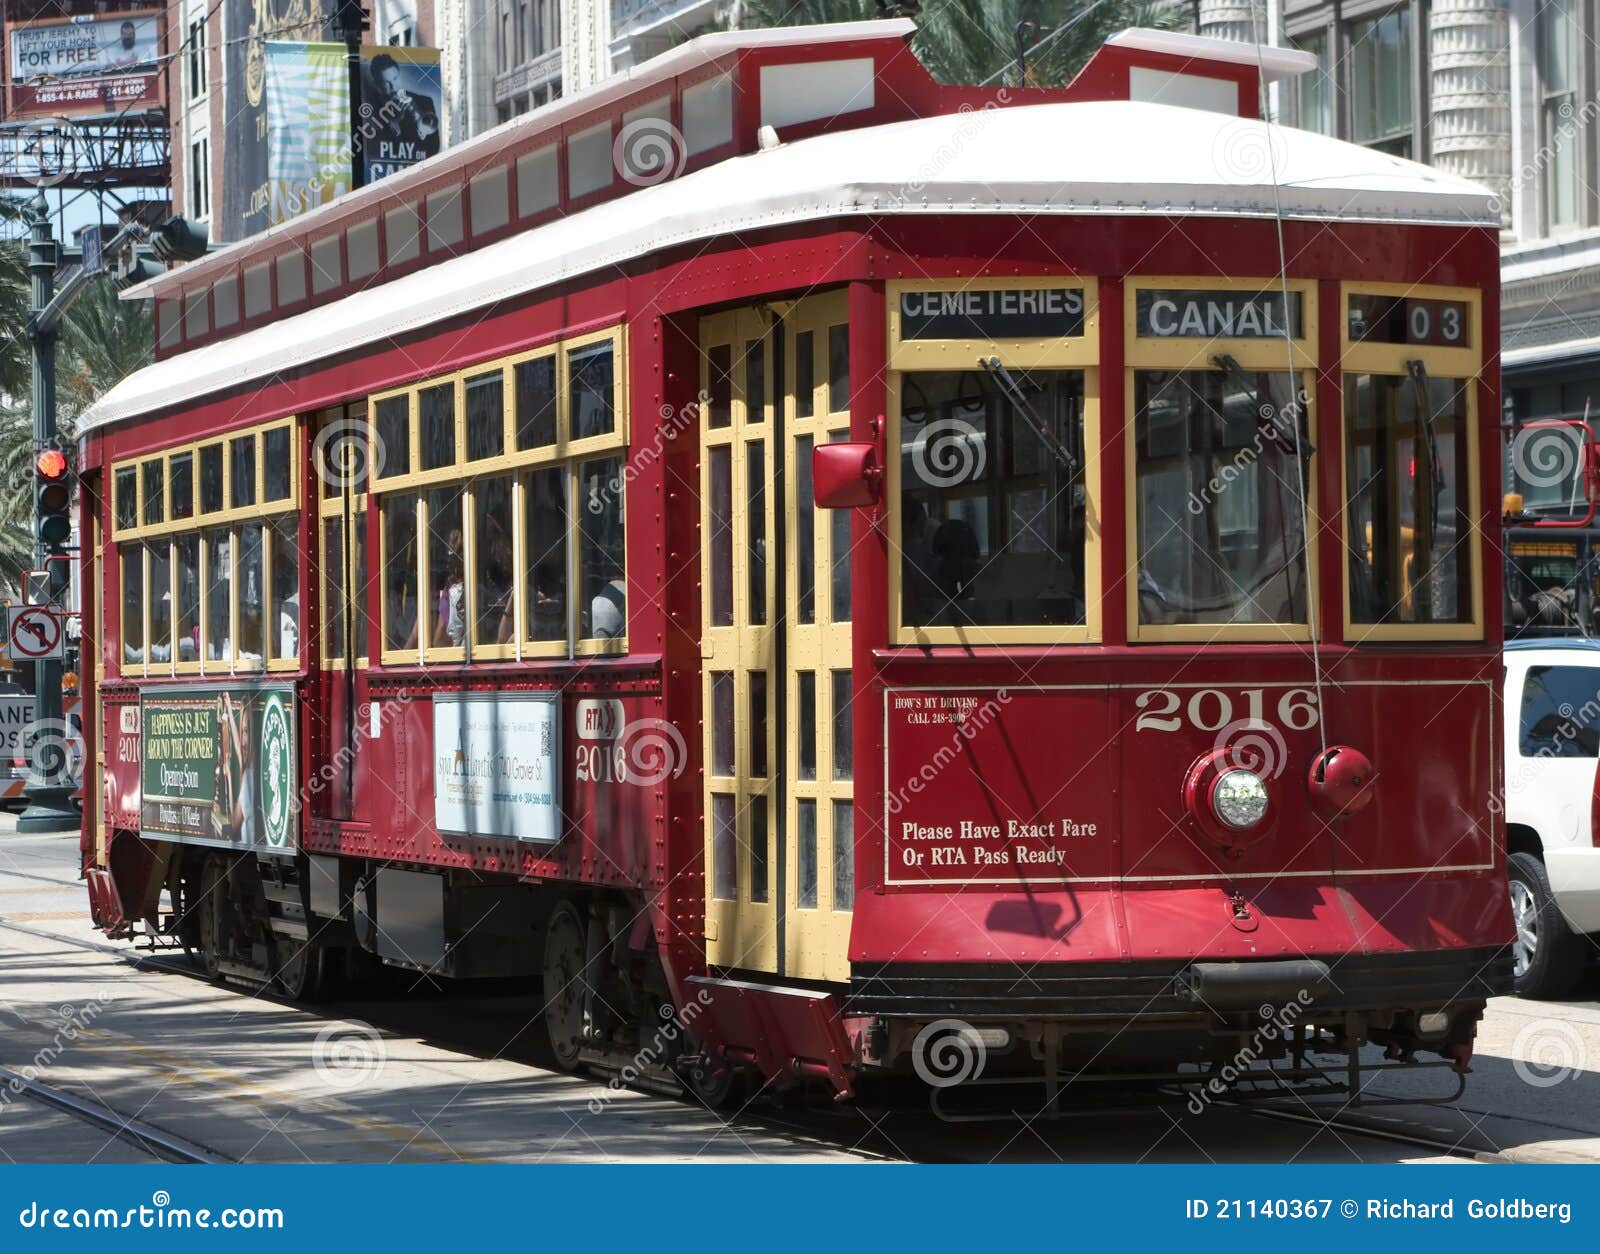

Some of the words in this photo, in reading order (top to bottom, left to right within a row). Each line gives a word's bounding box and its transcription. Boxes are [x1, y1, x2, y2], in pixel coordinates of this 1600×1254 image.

[18, 31, 44, 41] TRUST
[85, 26, 96, 35] TO
[19, 41, 38, 52] LIFT
[41, 39, 67, 49] YOUR
[19, 51, 50, 67] FOR
[57, 48, 97, 64] FREE
[380, 141, 415, 159] PLAY
[416, 151, 427, 160] ON
[902, 290, 1083, 317] CEMETERIES
[1150, 299, 1287, 336] CANAL
[895, 697, 921, 709] HOW'S
[924, 697, 937, 709] MY
[941, 697, 978, 709] DRIVING
[1135, 688, 1320, 733] 2016
[152, 713, 184, 735] HAPPINESS
[185, 712, 192, 734] IS
[193, 711, 210, 734] JUST
[585, 707, 604, 732] RTA
[908, 713, 930, 724] CALL
[148, 738, 170, 760] AROUND
[171, 738, 184, 760] THE
[184, 737, 213, 759] CORNER!
[576, 744, 627, 784] 2016
[160, 762, 184, 796] Opening
[184, 763, 199, 789] Soon
[902, 822, 953, 841] Please
[960, 820, 1001, 840] Have
[1007, 820, 1055, 839] Exact
[1062, 818, 1097, 838] Fare
[902, 847, 924, 867] Or
[931, 847, 967, 866] RTA
[974, 846, 1009, 865] Pass
[1016, 845, 1066, 866] Ready
